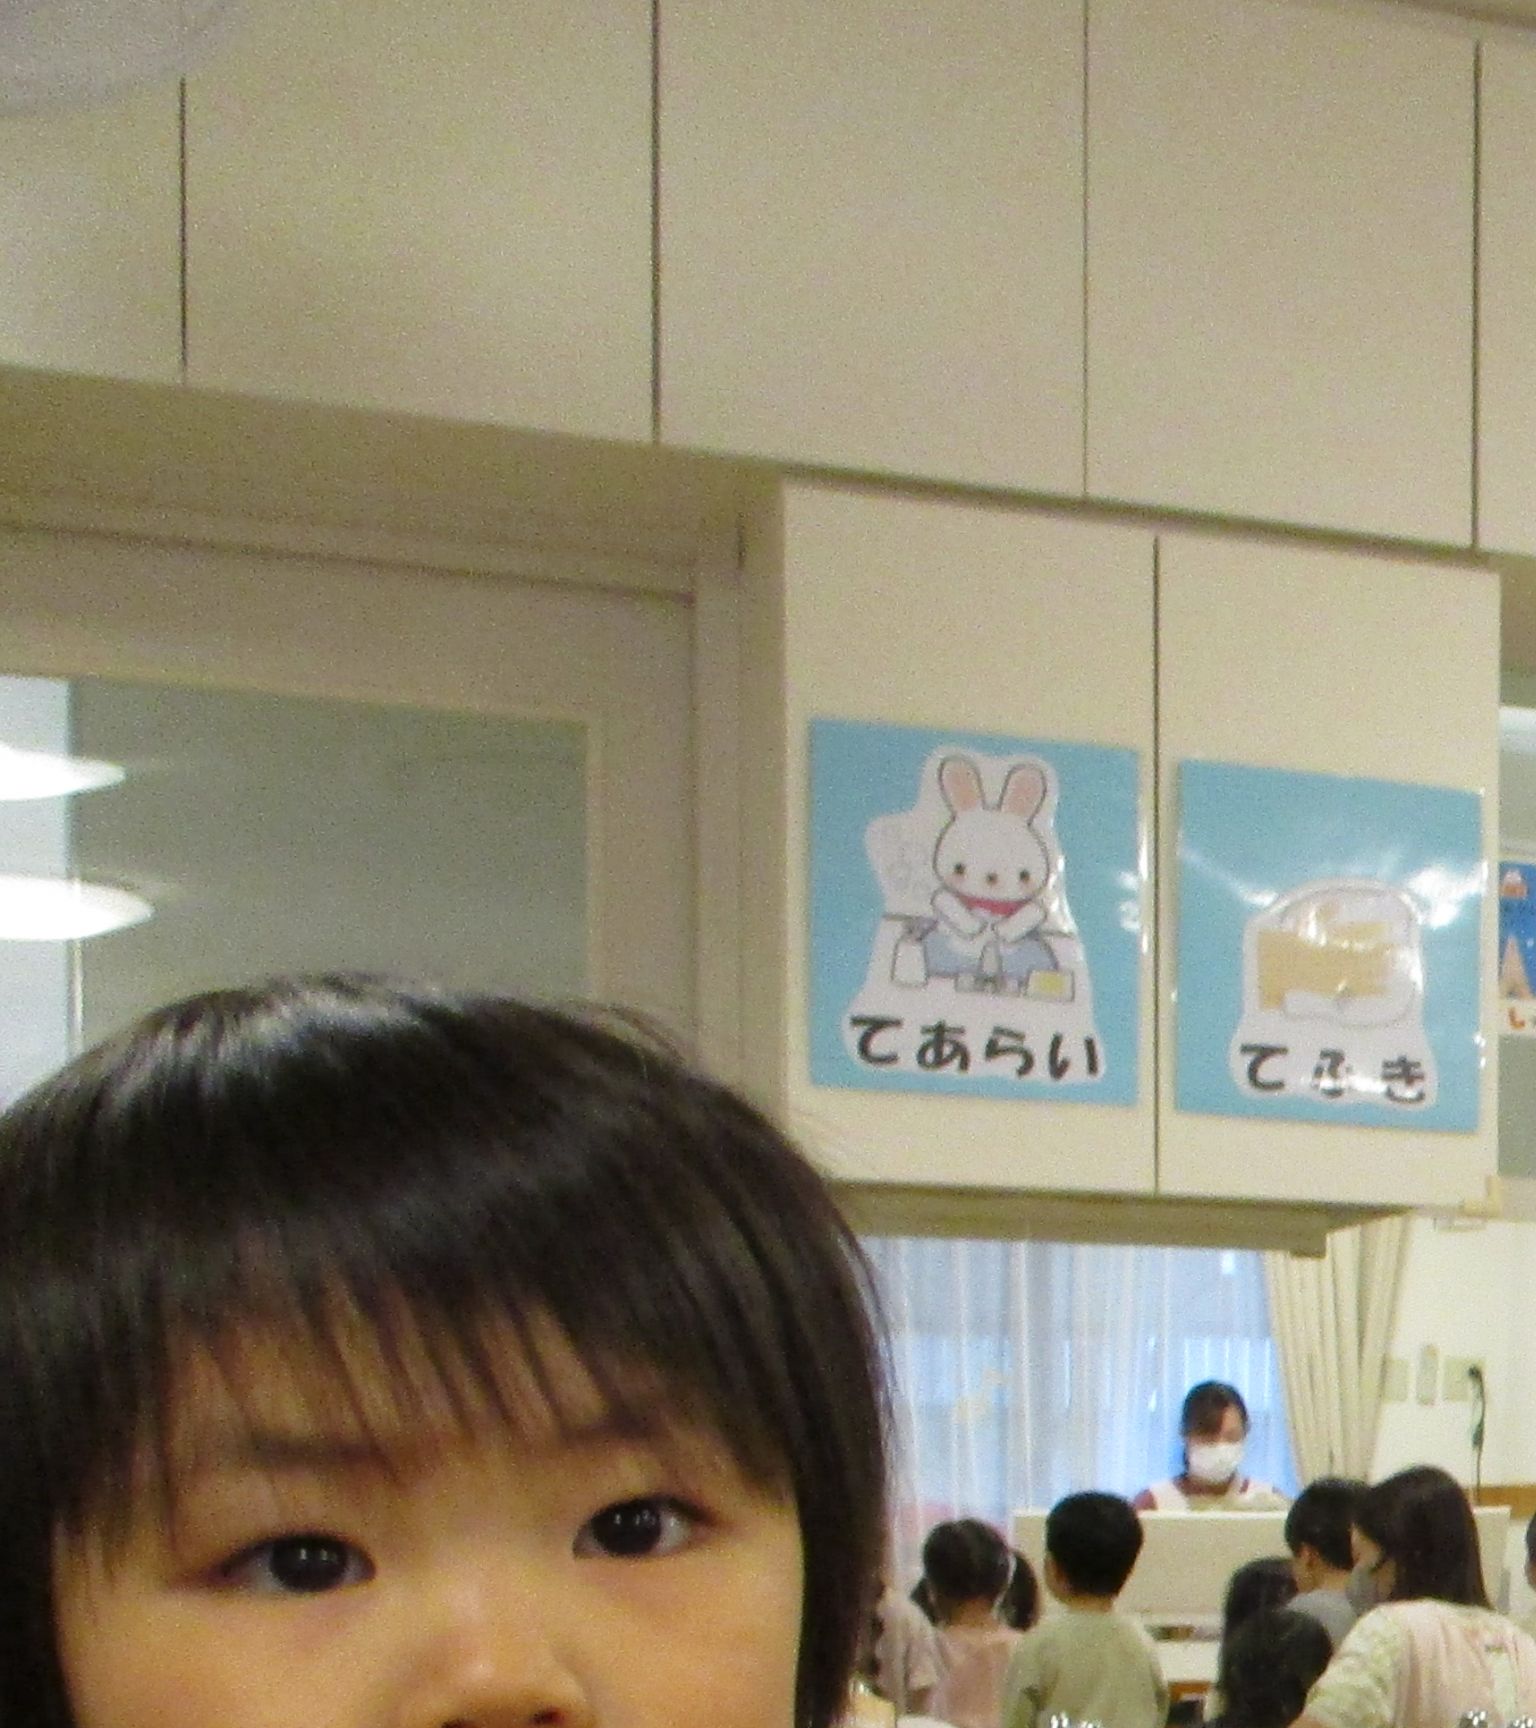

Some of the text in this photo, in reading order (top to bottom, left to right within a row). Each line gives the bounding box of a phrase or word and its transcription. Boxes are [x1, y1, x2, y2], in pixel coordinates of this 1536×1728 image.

[849, 1014, 1099, 1081] てあらい
[1239, 1042, 1427, 1104] てふき
